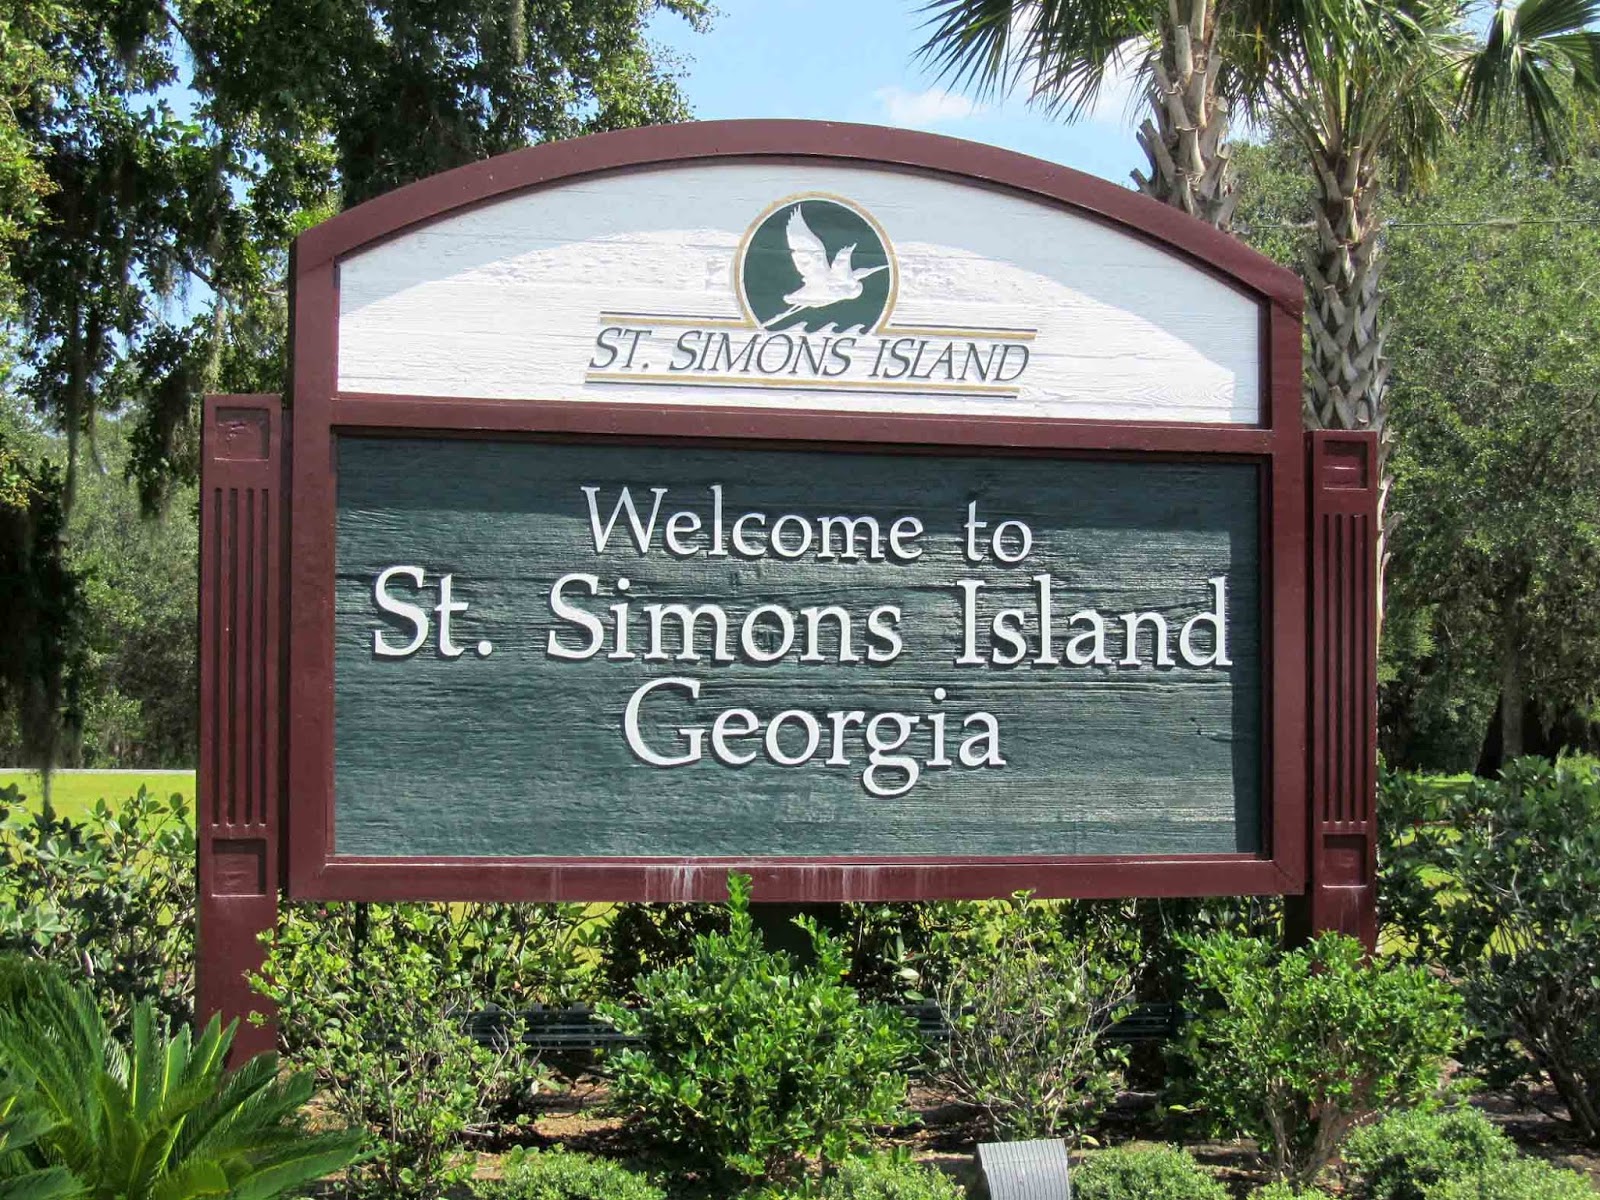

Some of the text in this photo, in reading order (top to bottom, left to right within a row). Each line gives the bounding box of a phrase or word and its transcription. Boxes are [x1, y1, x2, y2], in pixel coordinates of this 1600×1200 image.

[589, 327, 1030, 382] ST. SIMONS ISLAND
[580, 485, 1035, 562] Welcome to
[373, 565, 1233, 666] St. Simons Island
[623, 676, 1007, 797] Georgia
